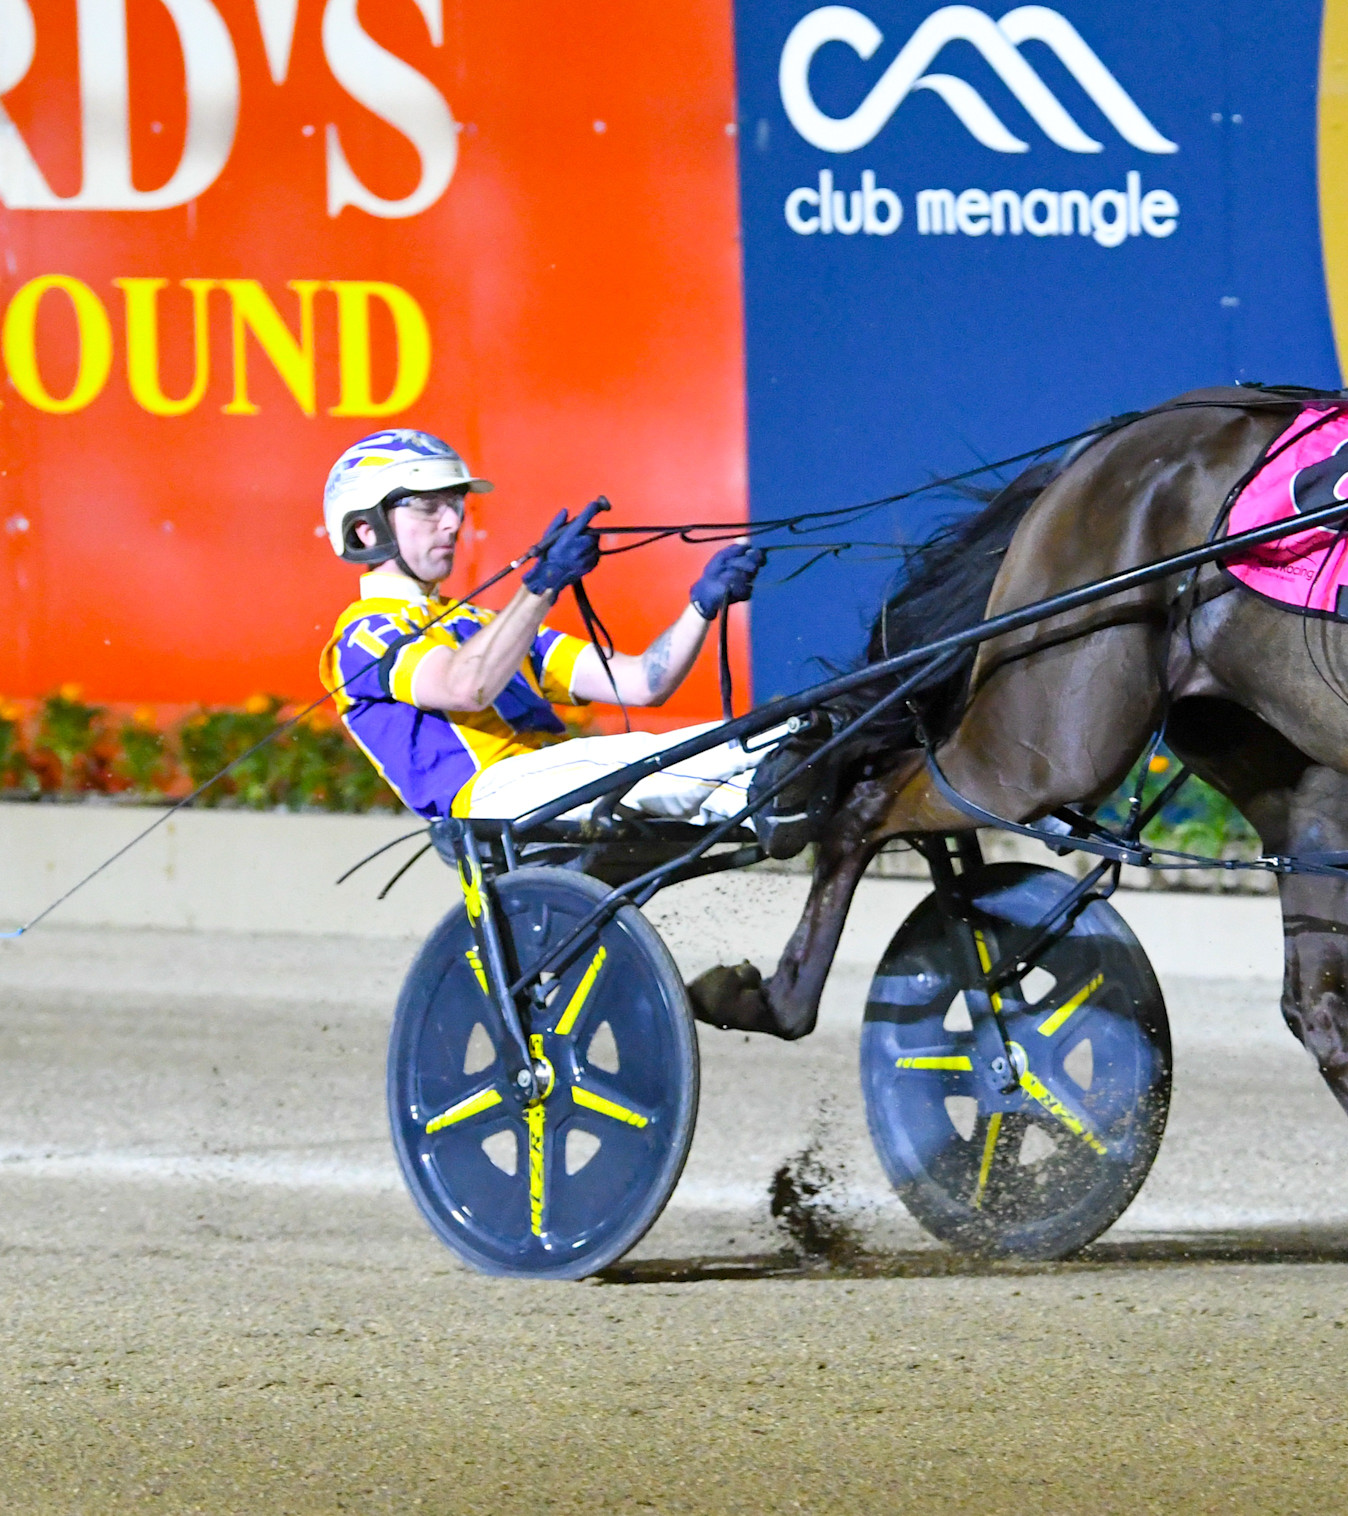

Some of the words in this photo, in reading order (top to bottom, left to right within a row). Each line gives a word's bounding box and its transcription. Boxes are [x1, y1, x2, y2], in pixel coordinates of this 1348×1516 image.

[784, 169, 902, 236] club
[917, 170, 1180, 248] menangle
[2, 273, 431, 418] OUND
